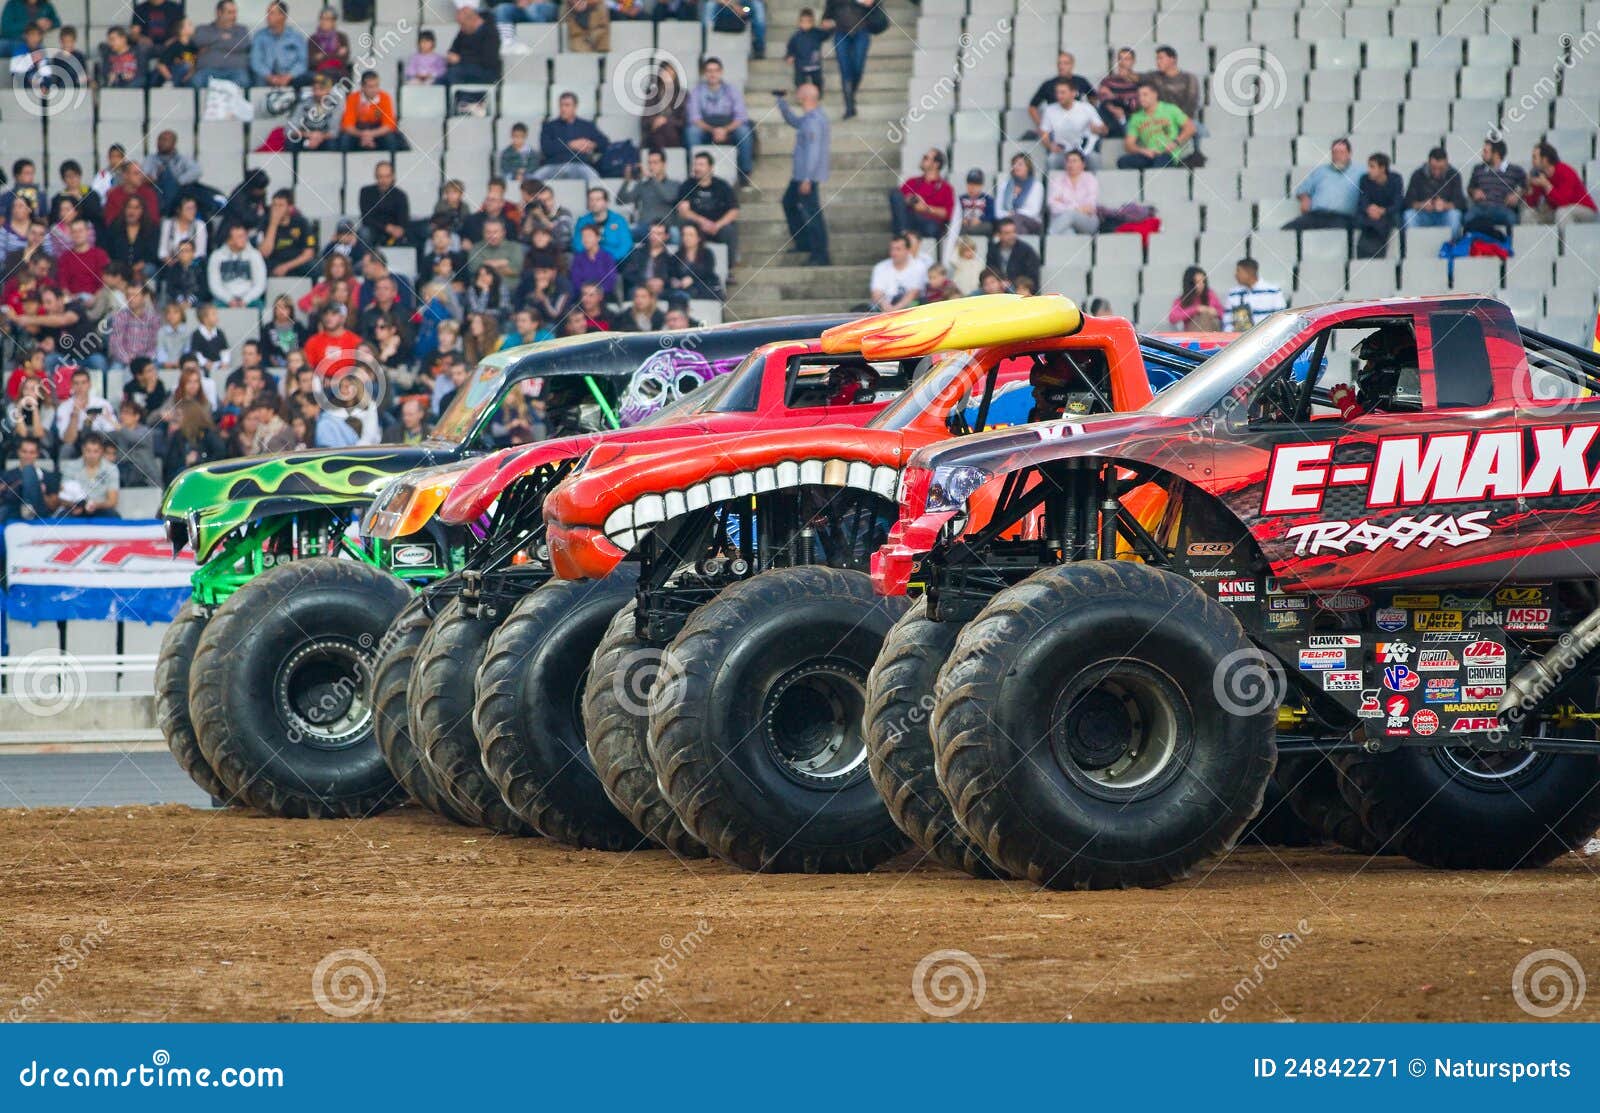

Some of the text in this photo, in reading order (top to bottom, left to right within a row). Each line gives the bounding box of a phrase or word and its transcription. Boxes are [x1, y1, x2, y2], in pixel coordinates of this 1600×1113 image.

[1261, 424, 1600, 512] E-MAX
[1286, 510, 1493, 555] TRAXXAS
[1218, 581, 1255, 592] KING
[1429, 611, 1456, 621] Auto
[1468, 611, 1504, 628] piloti
[1506, 608, 1549, 622] MSD
[1426, 620, 1460, 629] Meter
[1507, 622, 1546, 630] PRO MAG
[1310, 636, 1343, 646] HAWK
[1464, 641, 1505, 657] JAZ
[1301, 651, 1343, 659] FEL-PRO
[1384, 664, 1410, 691] VP
[1469, 668, 1505, 678] CROWER
[1465, 686, 1504, 699] WORLD
[1444, 703, 1498, 712] MAGNAFLO
